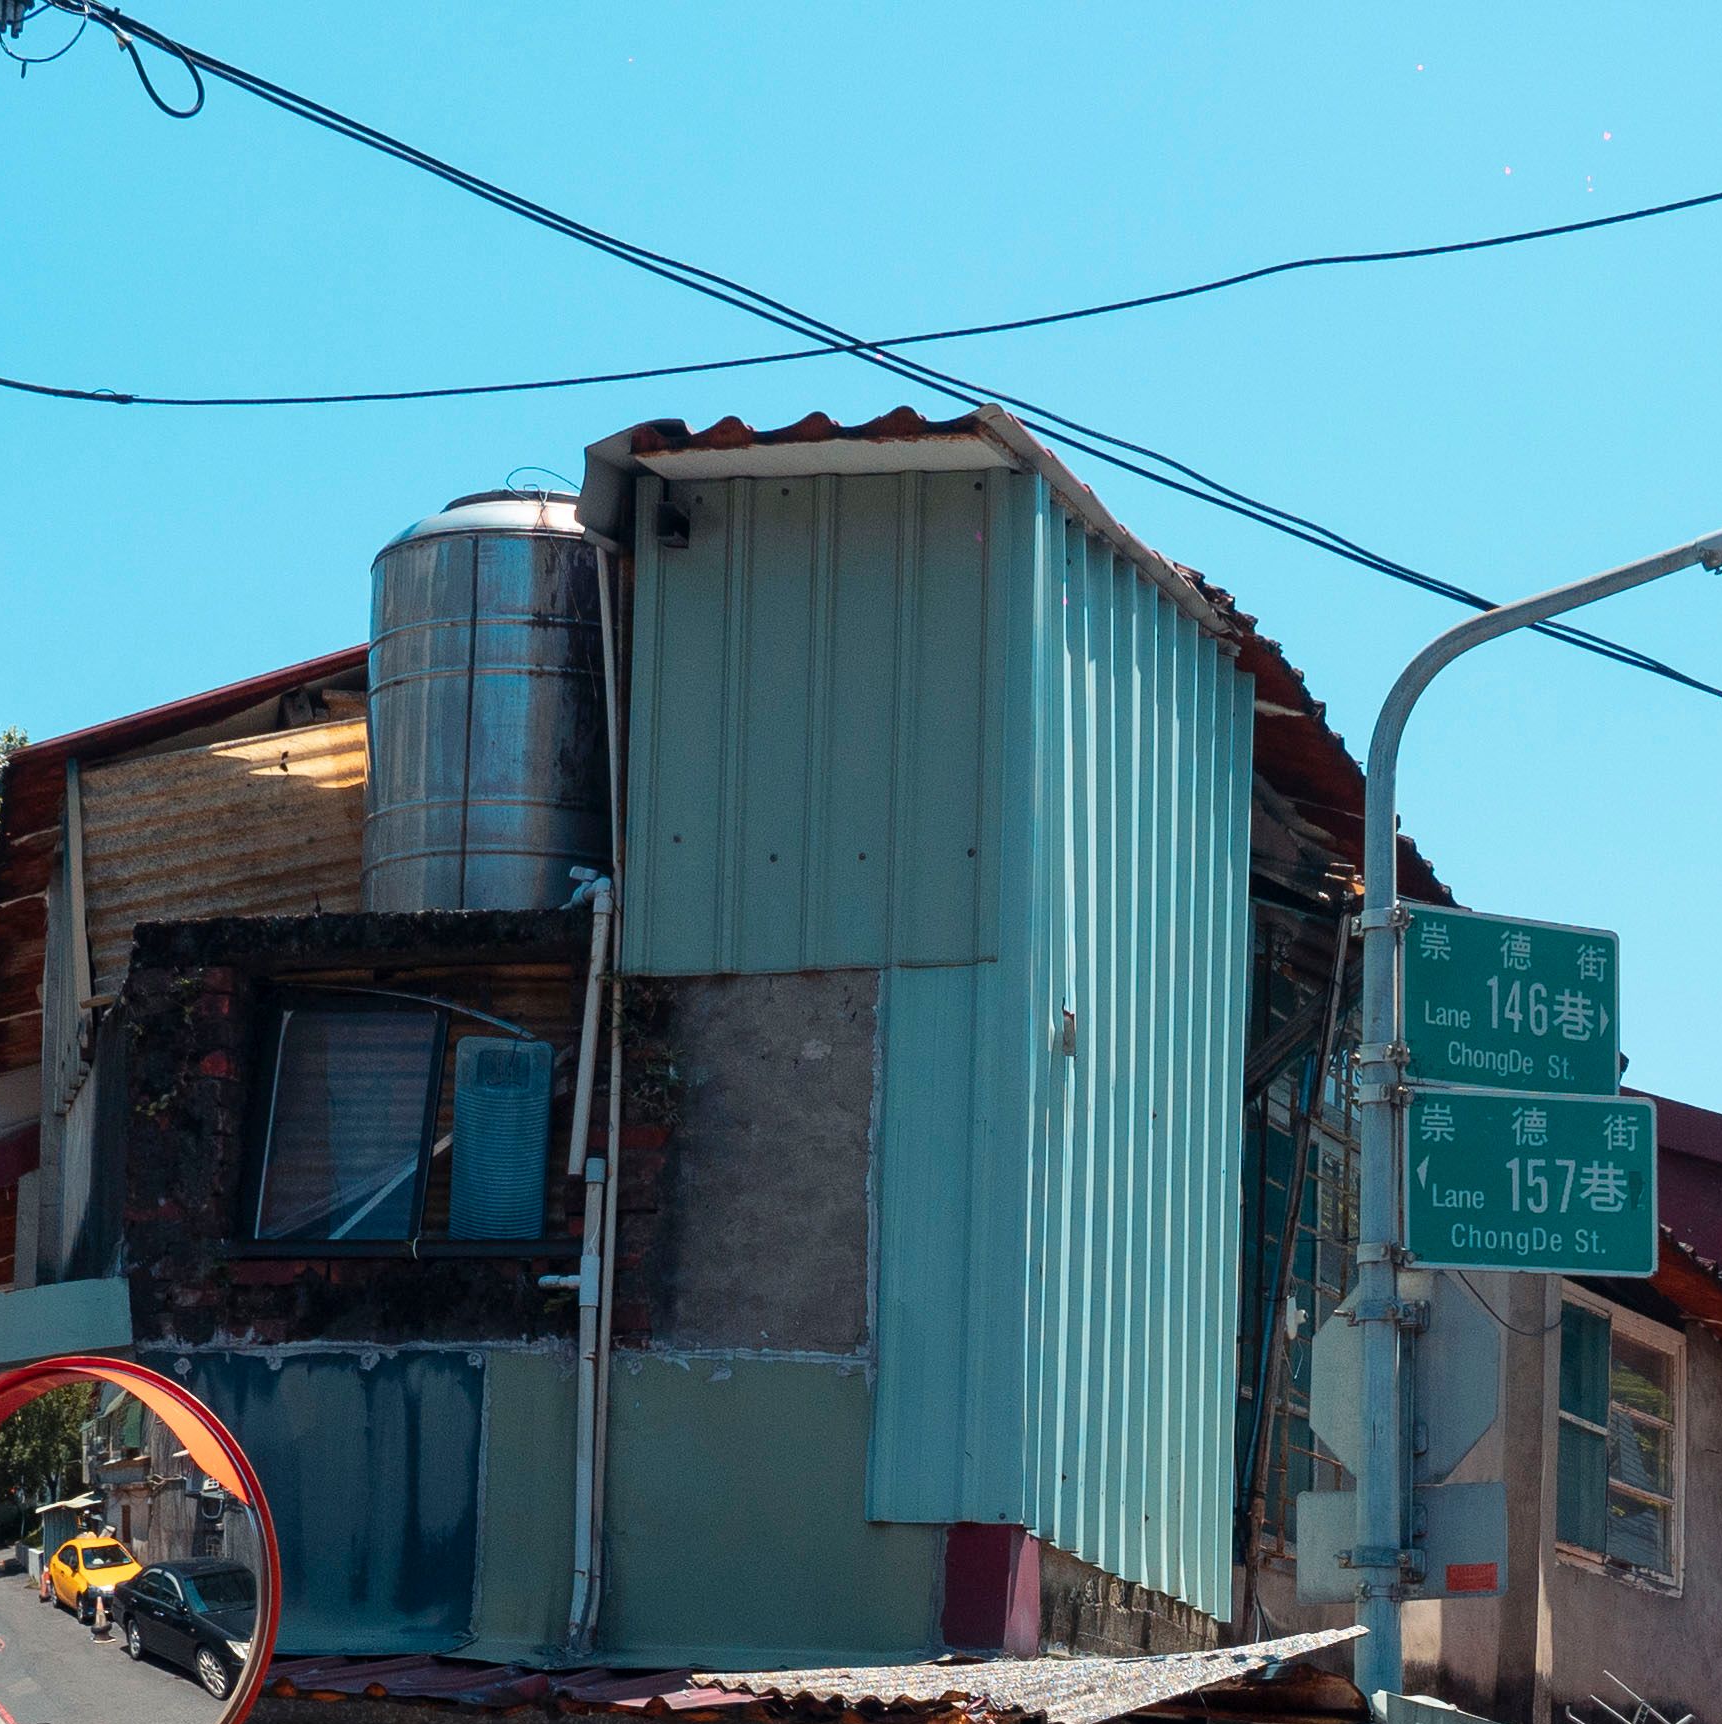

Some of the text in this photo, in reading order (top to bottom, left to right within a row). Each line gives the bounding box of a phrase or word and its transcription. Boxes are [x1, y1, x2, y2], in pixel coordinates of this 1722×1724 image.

[1420, 922, 1607, 982] 崇德街
[1425, 976, 1595, 1041] Lane 146巷
[1448, 1041, 1575, 1080] ChongDe St.
[1420, 1104, 1639, 1151] 崇德街
[1432, 1159, 1627, 1213] Lane 157巷
[1451, 1224, 1606, 1254] ChongDe St.
